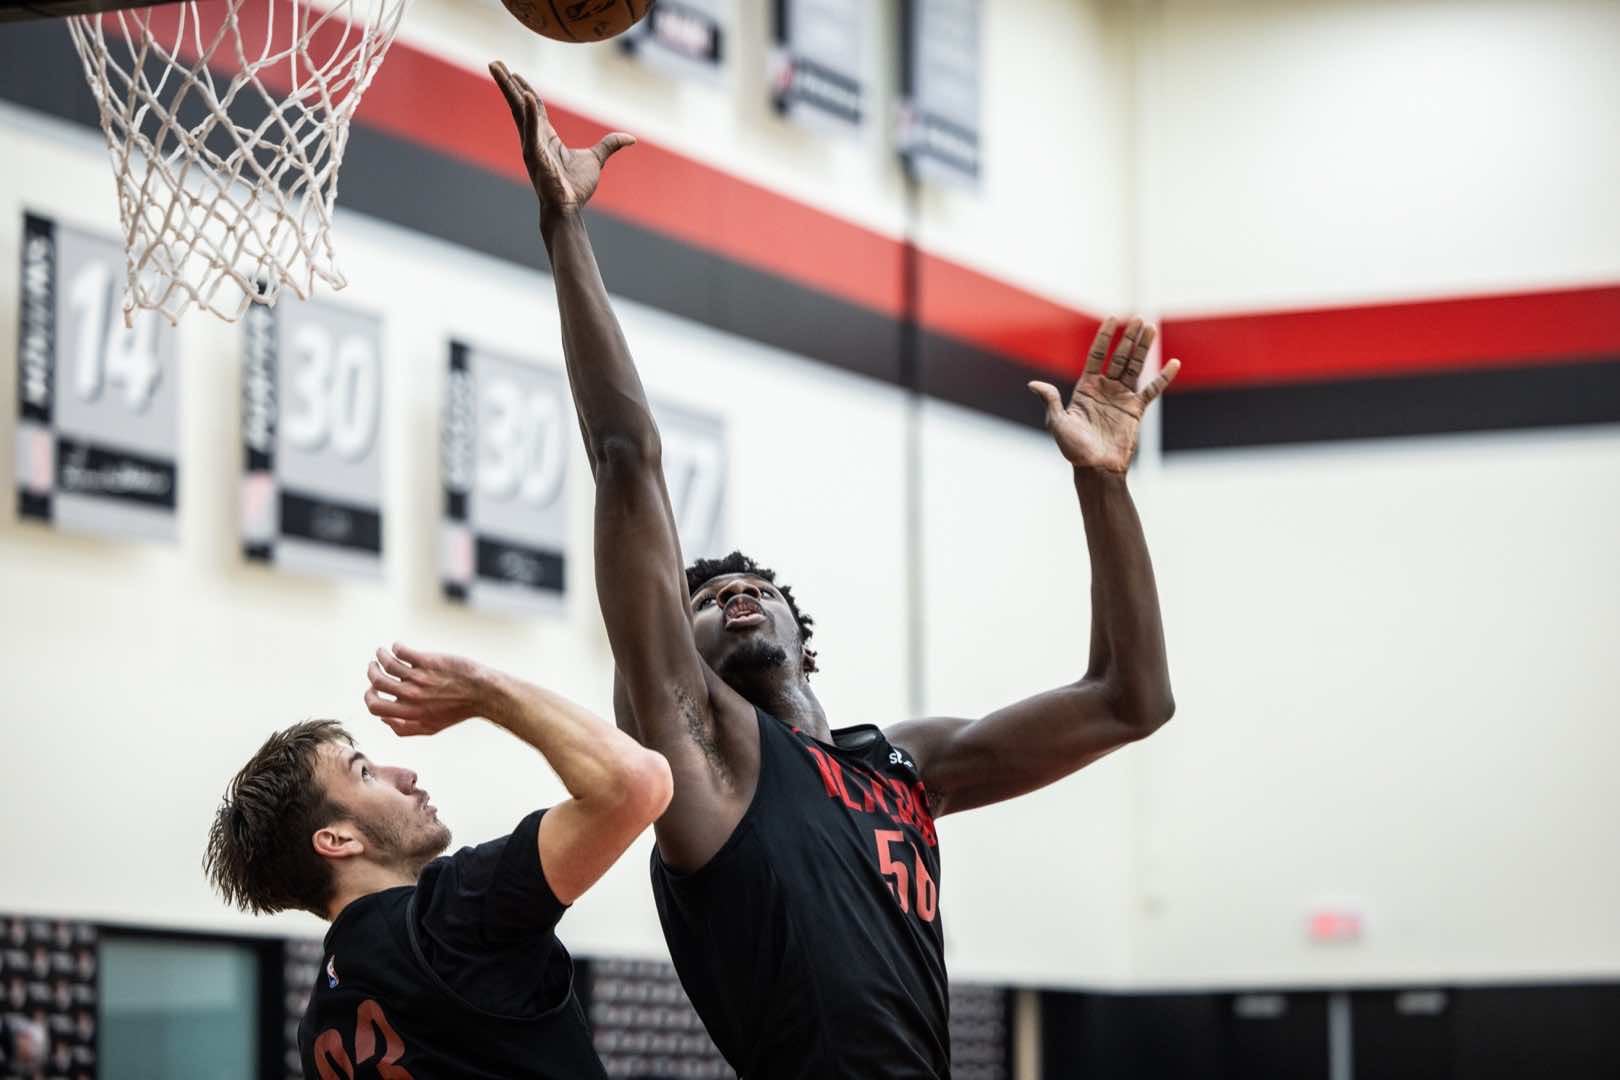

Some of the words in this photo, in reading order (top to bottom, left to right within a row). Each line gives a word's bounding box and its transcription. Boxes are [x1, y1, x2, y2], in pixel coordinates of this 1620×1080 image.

[71, 258, 160, 411] 14
[283, 322, 377, 460] 30
[479, 379, 564, 506] 30
[874, 828, 938, 922] 56
